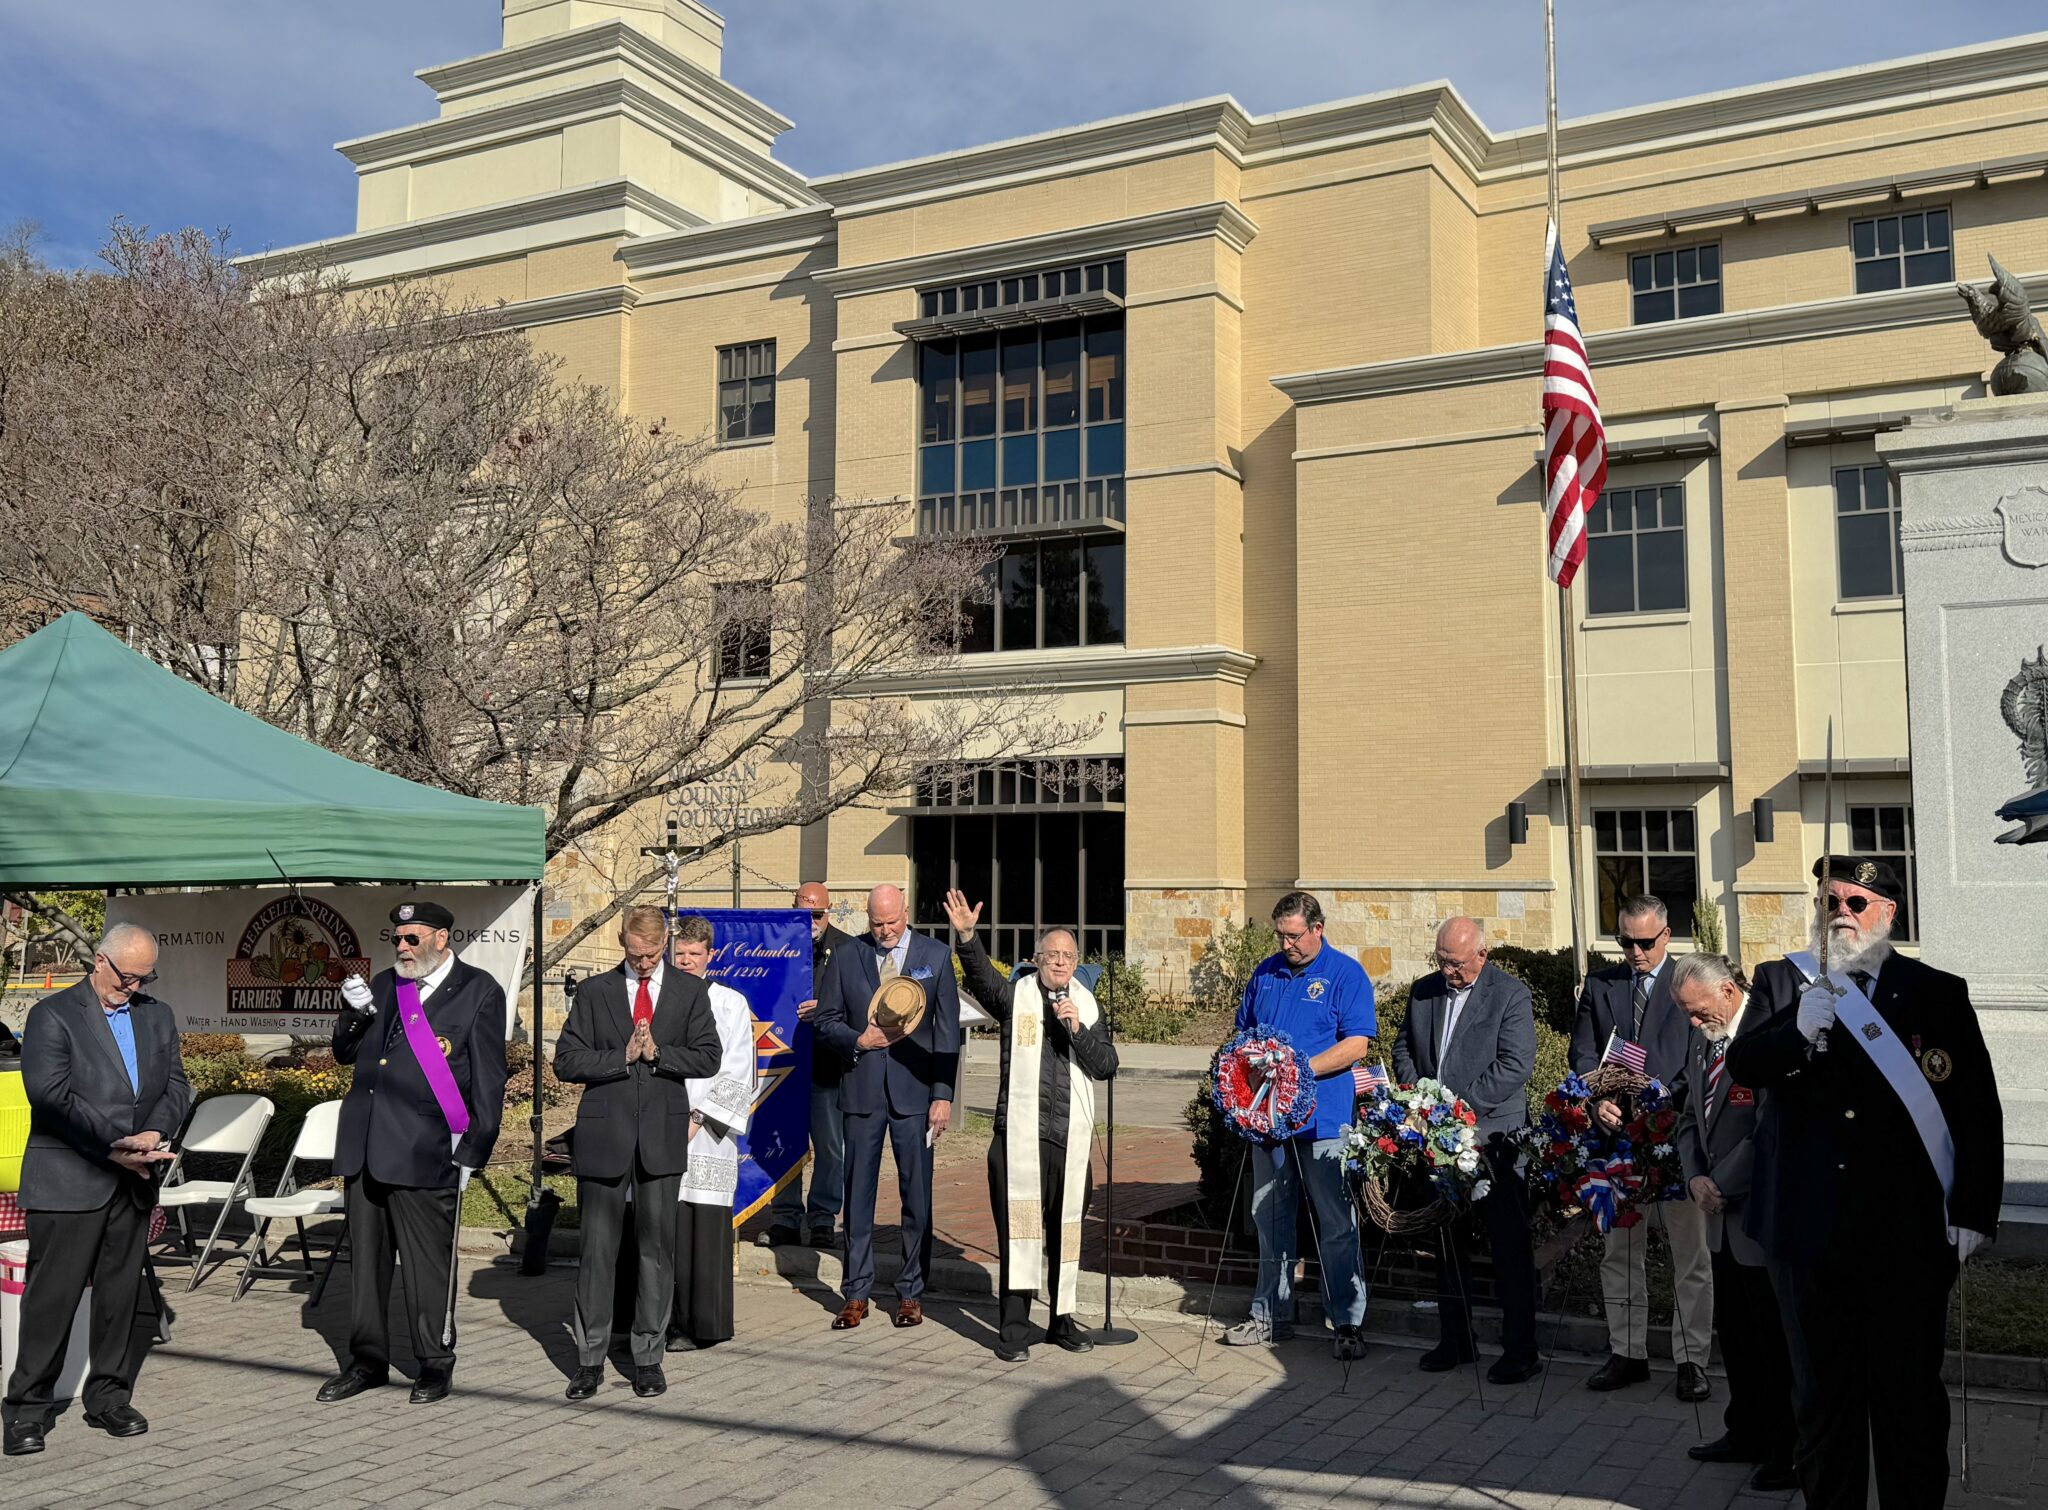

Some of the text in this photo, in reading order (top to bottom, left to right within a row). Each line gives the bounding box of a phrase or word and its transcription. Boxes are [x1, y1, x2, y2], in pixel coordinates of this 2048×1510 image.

[2021, 527, 2048, 537] WAR
[667, 785, 752, 806] COUNTY
[241, 899, 355, 956] BERKELEY SPRINGS
[452, 929, 520, 943] OKENS
[713, 940, 801, 961] of Columbus
[733, 966, 770, 978] 12191
[231, 988, 343, 1010] FARMERS MARK
[291, 1016, 337, 1029] STATIO
